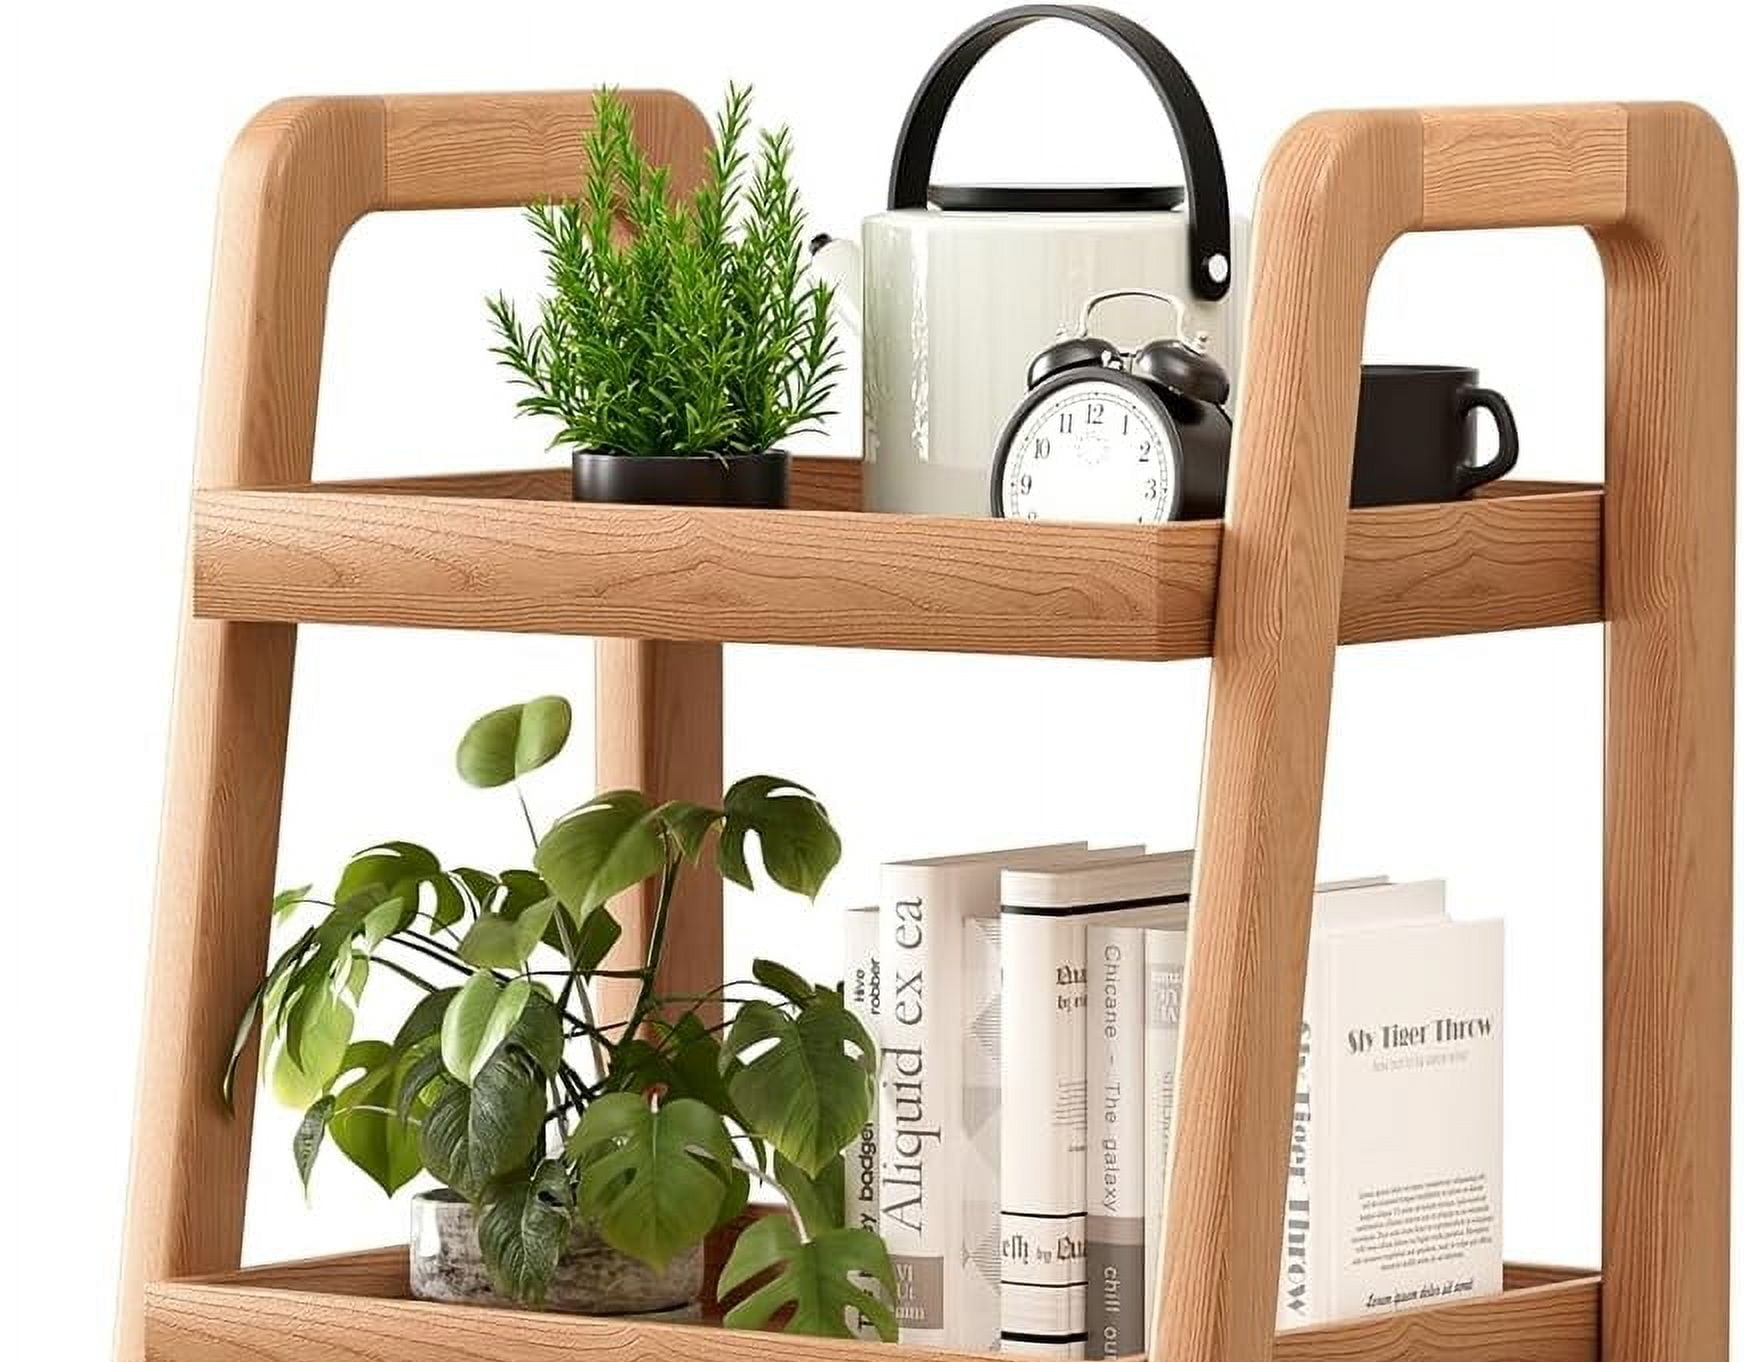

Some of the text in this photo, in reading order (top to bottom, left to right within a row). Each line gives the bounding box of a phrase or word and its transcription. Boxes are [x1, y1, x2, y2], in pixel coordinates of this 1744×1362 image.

[1059, 412, 1073, 434] 11
[1086, 403, 1105, 425] 12
[1122, 414, 1129, 436] 1
[1034, 437, 1051, 460] 10
[1138, 440, 1151, 463] 2
[1020, 474, 1033, 496] 9
[1144, 478, 1157, 501] 3
[1104, 945, 1122, 1039] Chicane
[1347, 1027, 1376, 1054] Sly
[1380, 1023, 1429, 1049] Tiger
[881, 896, 942, 1237] Aliquid ex ea
[1103, 1082, 1121, 1123] The
[1101, 1138, 1121, 1213] galaxy
[1287, 1196, 1311, 1316] Throw
[1103, 1265, 1121, 1313] chill
